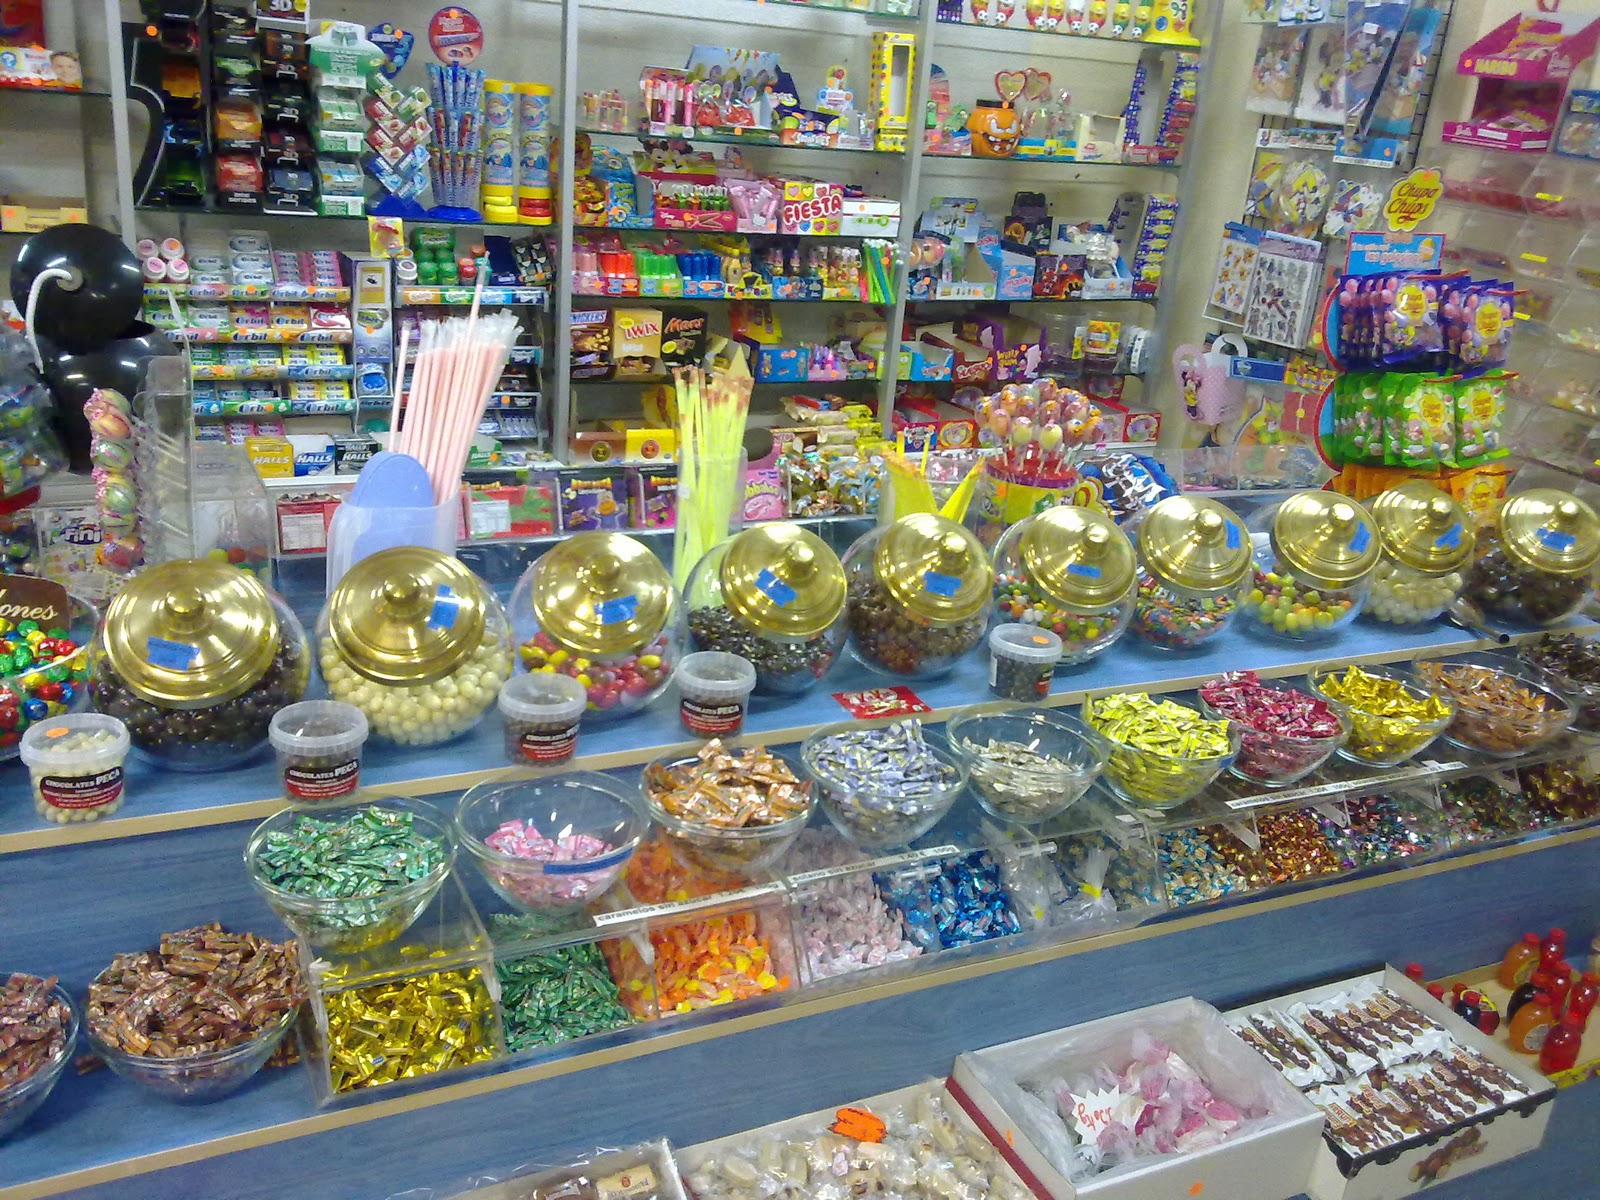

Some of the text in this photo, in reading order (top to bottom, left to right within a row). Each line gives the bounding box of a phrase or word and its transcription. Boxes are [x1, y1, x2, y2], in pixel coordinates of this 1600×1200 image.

[1397, 182, 1439, 200] Chupa
[783, 194, 843, 226] FIESTA
[1388, 198, 1430, 214] Chups
[625, 322, 660, 340] TWIX
[664, 317, 705, 334] Mars
[253, 455, 290, 466] HALLS
[296, 455, 333, 464] HALLS
[343, 452, 373, 461] HALLS
[334, 761, 358, 777] PECA
[45, 768, 120, 789] CHOCOLATES PECA
[828, 866, 843, 877] sin
[658, 901, 676, 911] sin
